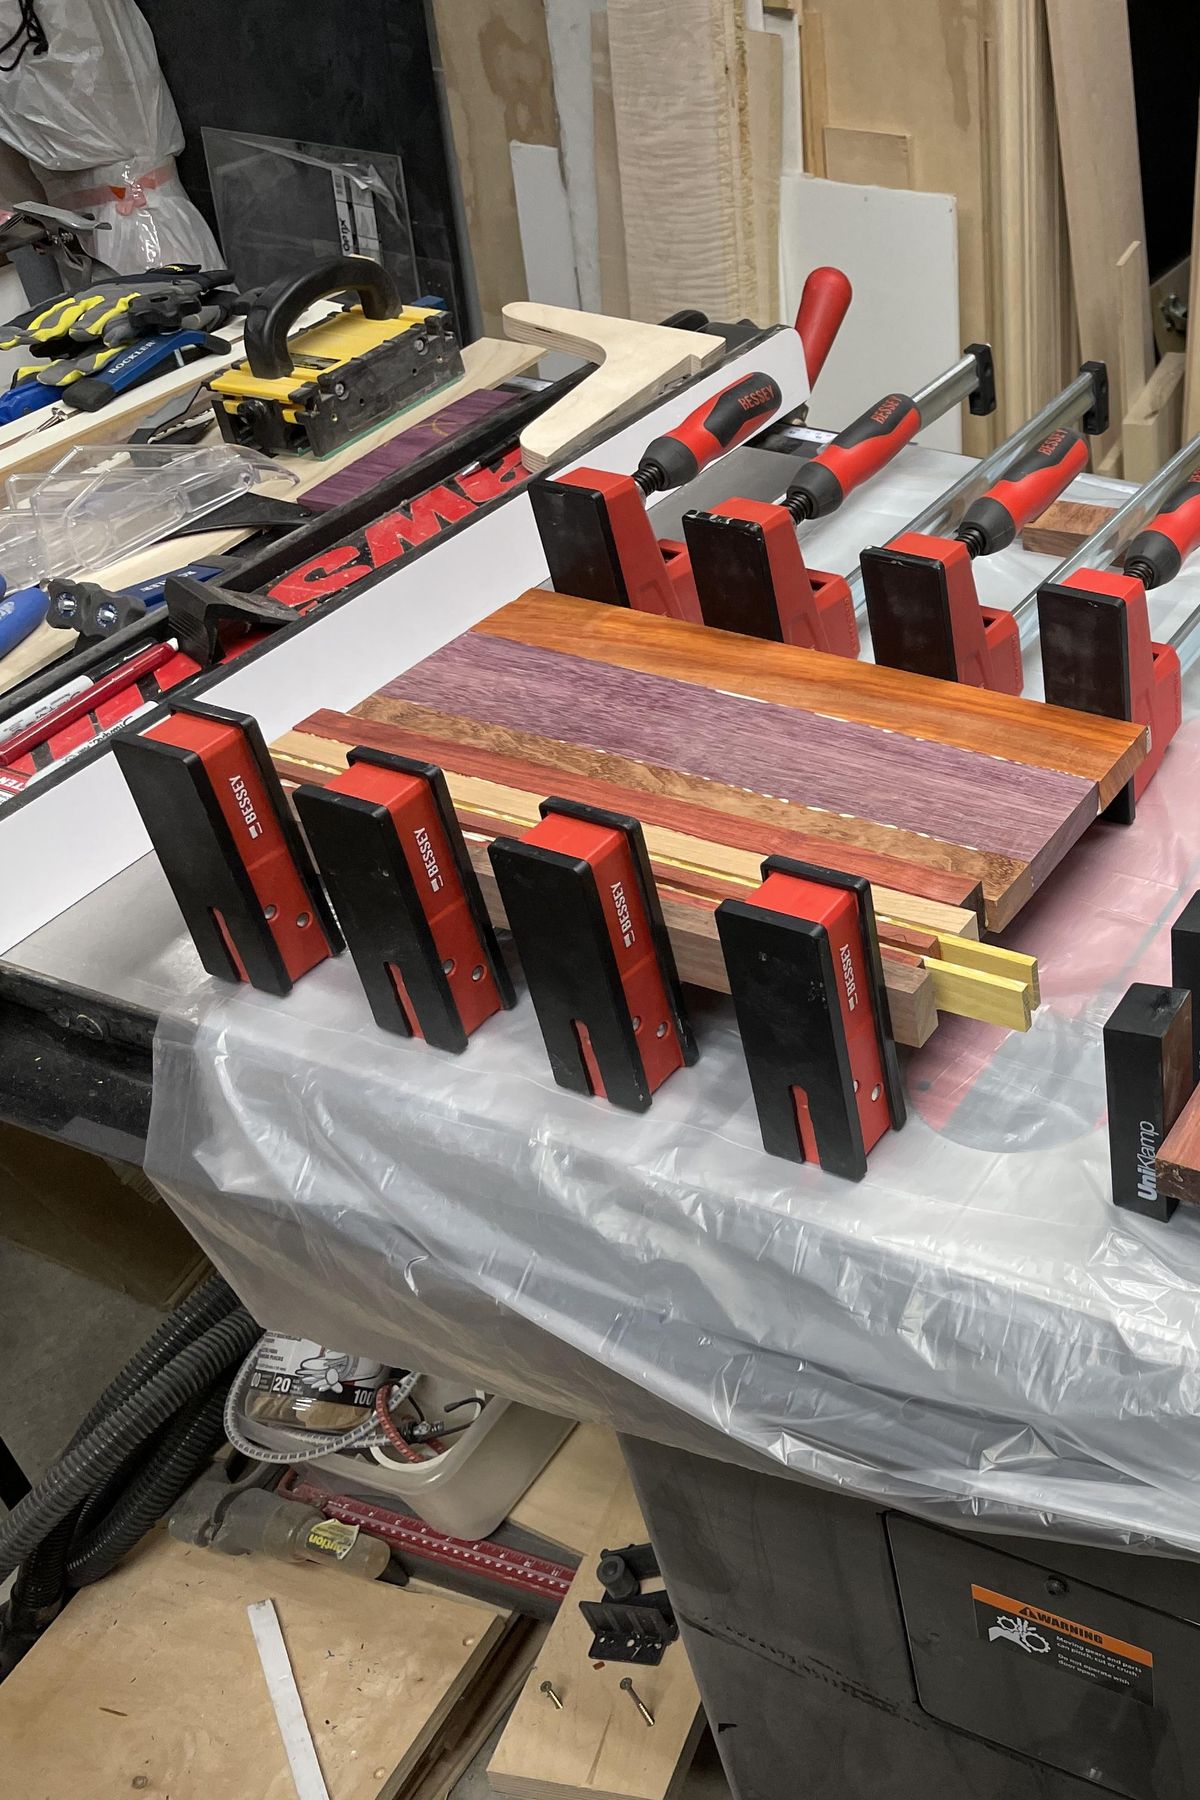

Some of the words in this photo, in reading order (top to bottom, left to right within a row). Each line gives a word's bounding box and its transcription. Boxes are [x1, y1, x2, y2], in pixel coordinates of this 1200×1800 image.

[108, 340, 156, 375] ROCKLER
[737, 384, 775, 411] BESSEY
[870, 395, 902, 425] BESSEY
[228, 775, 258, 826] BESSEY
[413, 827, 440, 878] BESSEY
[609, 881, 633, 934] BESSEY
[839, 943, 857, 998] BESSEY
[1137, 1120, 1160, 1202] UniKlamp
[272, 1376, 292, 1394] 20
[1037, 1612, 1103, 1645] WARNING
[1056, 1635, 1085, 1651] Moving
[1086, 1645, 1106, 1659] gears
[1107, 1655, 1121, 1665] and
[1122, 1661, 1142, 1674] parts
[1057, 1643, 1070, 1651] can
[1094, 1655, 1106, 1665] cut
[1107, 1661, 1116, 1670] or
[1116, 1665, 1140, 1678] crush.
[1057, 1653, 1068, 1661] Do
[1069, 1658, 1082, 1667] not
[1083, 1663, 1112, 1680] operate
[1113, 1673, 1130, 1686] with
[1058, 1659, 1076, 1670] door
[1077, 1667, 1098, 1679] open.
